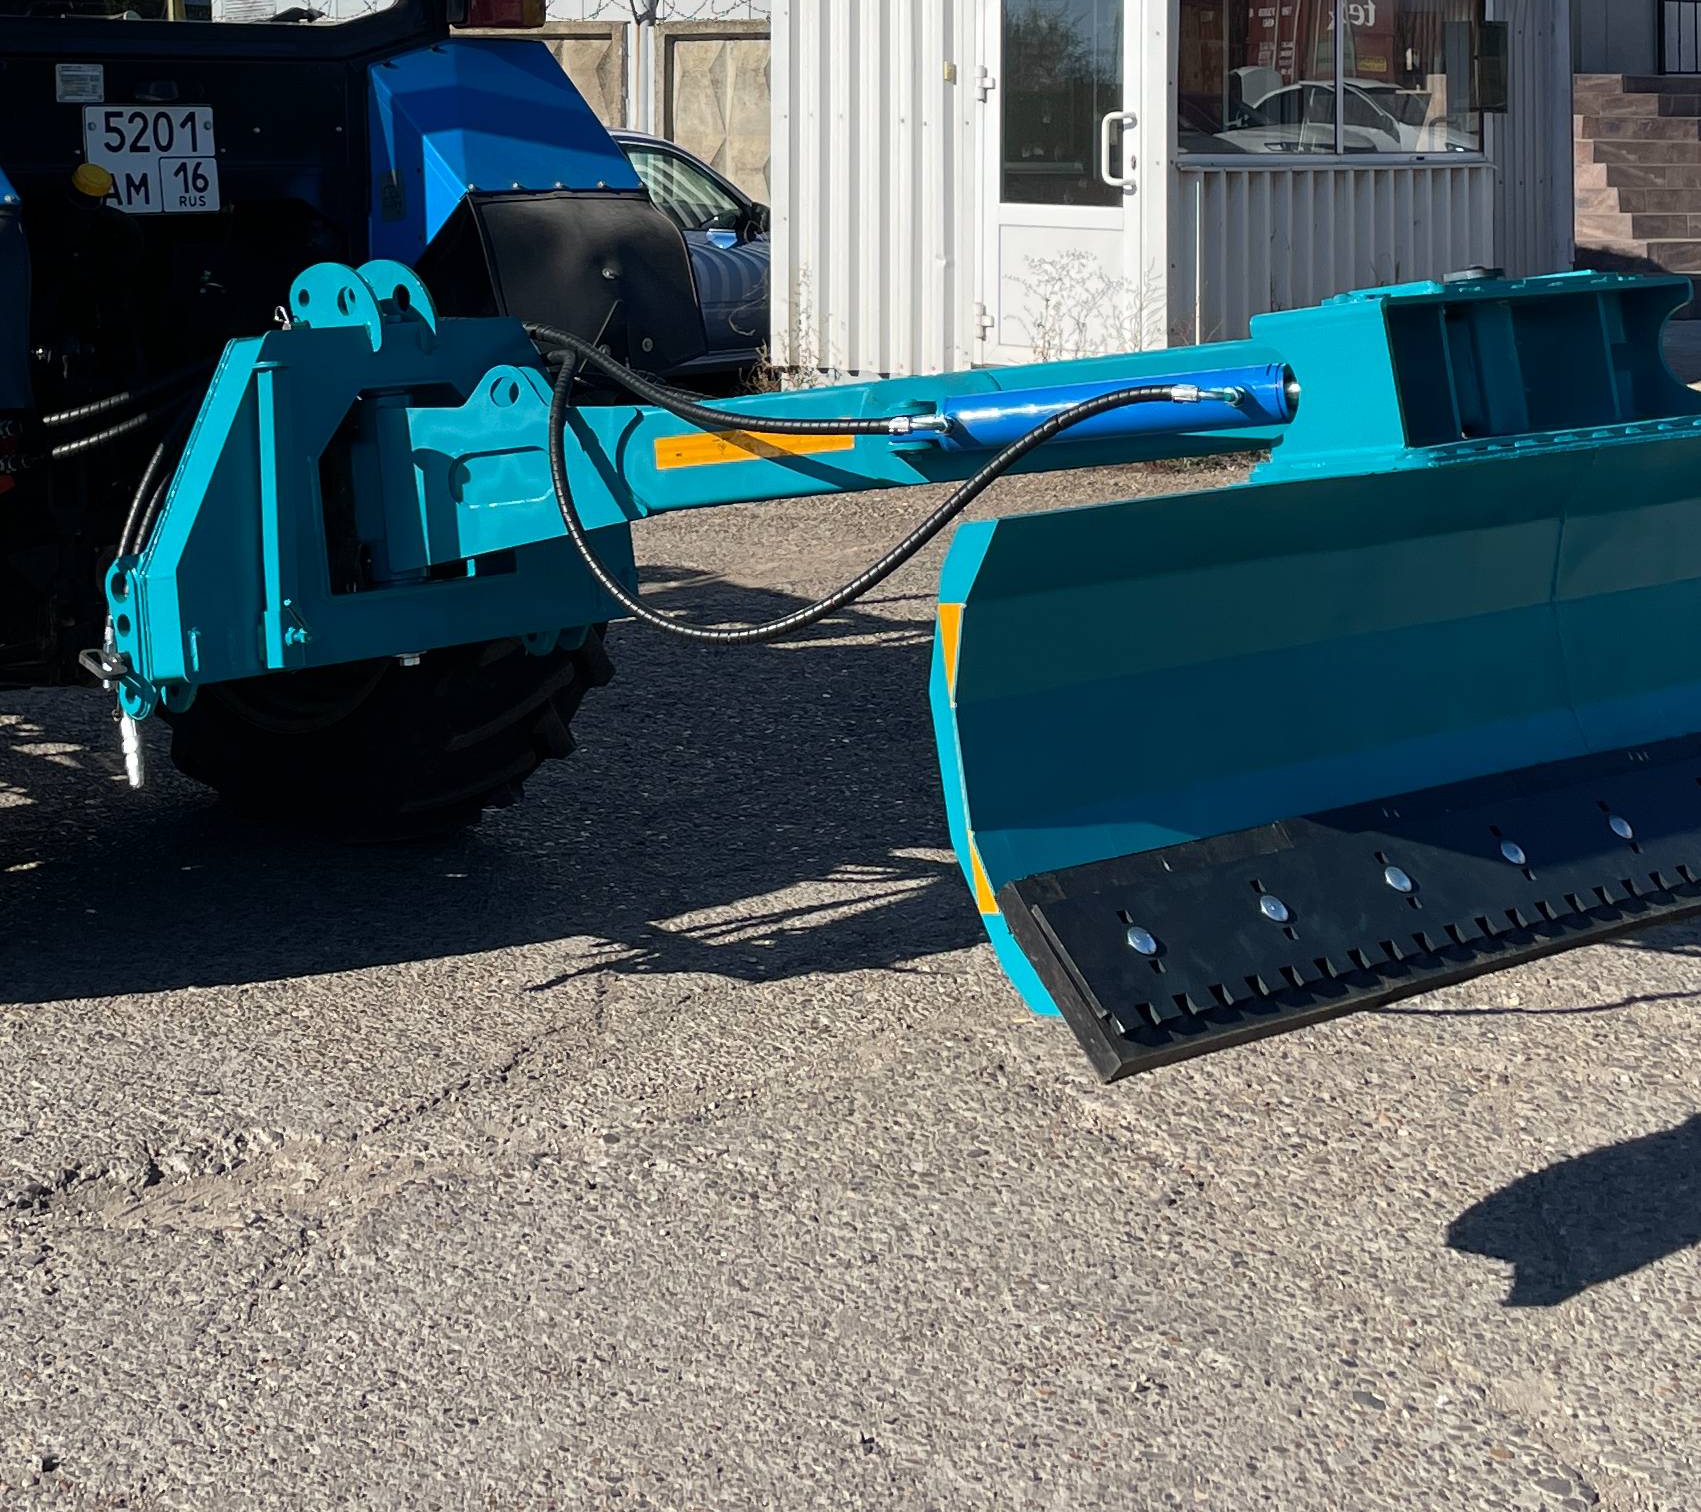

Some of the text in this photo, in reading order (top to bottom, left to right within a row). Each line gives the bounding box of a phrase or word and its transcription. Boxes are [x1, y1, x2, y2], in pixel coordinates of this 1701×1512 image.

[103, 110, 198, 153] 5201
[173, 161, 209, 194] 16
[179, 195, 206, 207] RUS
